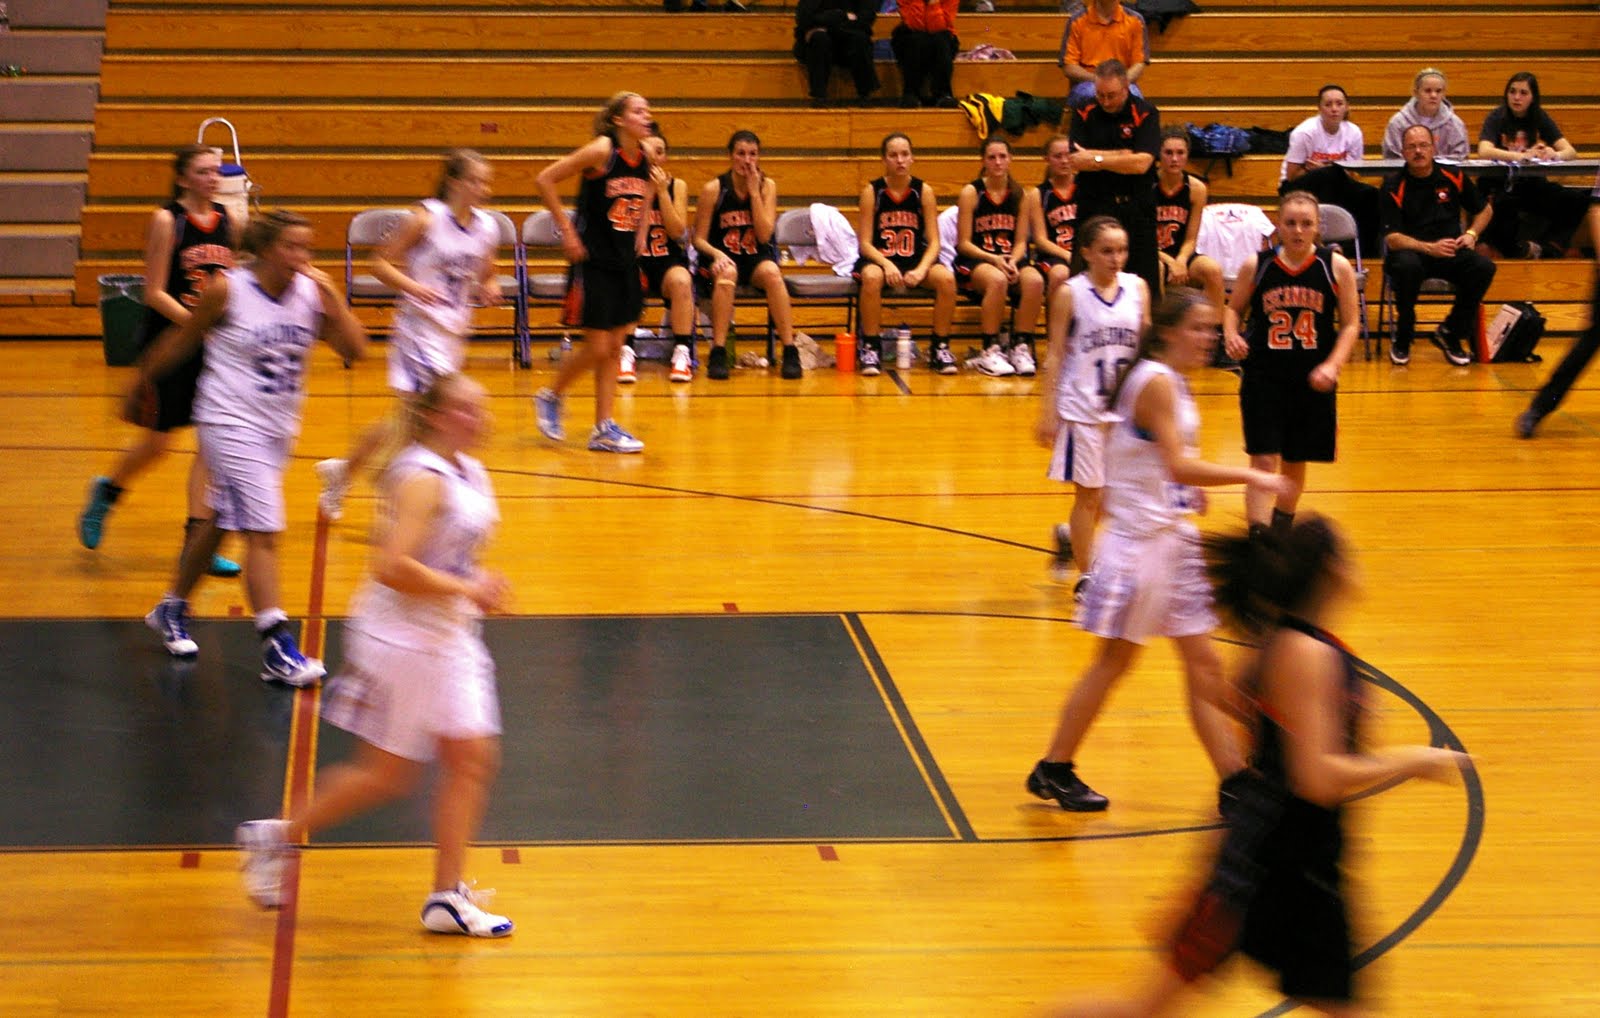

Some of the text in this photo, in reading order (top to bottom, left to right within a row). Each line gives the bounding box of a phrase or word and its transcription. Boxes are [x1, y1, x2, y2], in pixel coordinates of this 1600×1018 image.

[723, 229, 758, 255] 44
[880, 229, 915, 257] 30
[1267, 309, 1318, 350] 24
